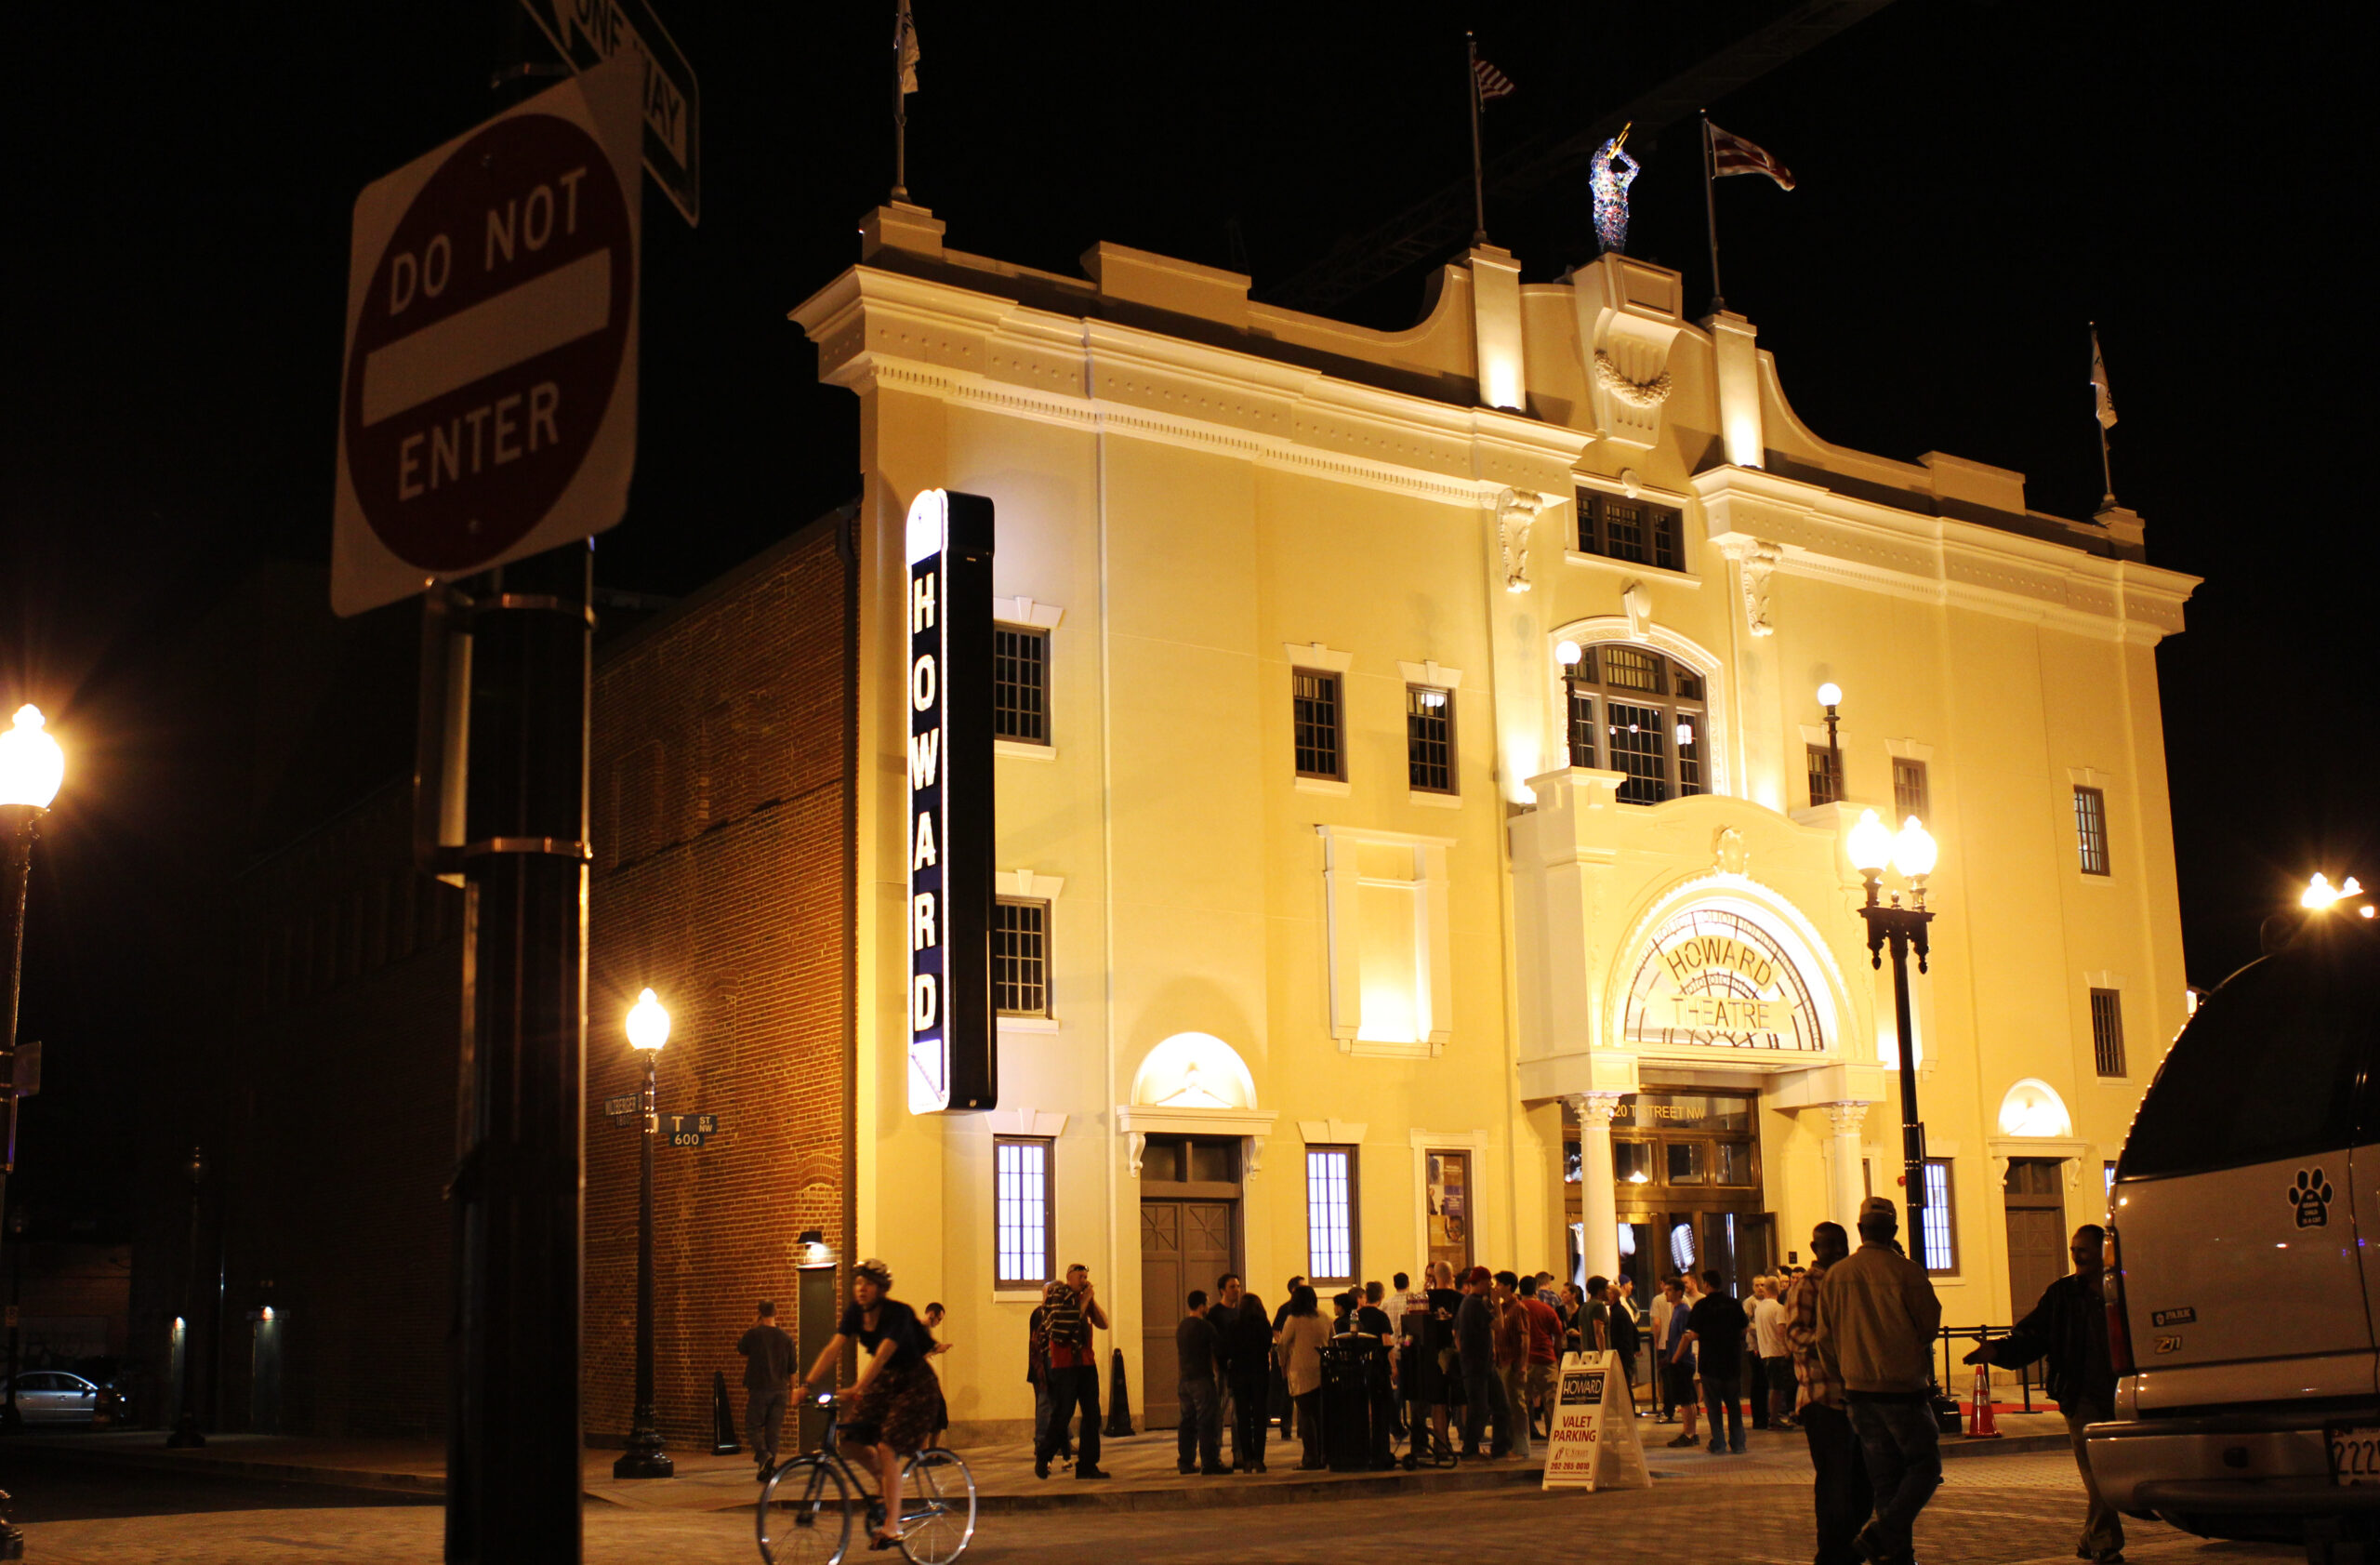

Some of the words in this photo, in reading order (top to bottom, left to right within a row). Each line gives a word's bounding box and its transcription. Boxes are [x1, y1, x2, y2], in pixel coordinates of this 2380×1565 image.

[640, 50, 680, 141] AY
[389, 233, 452, 317] DO
[484, 166, 588, 272] NOT
[397, 380, 560, 501] ENTER
[912, 573, 939, 1031] HOWARD
[1667, 938, 1771, 987] HOWARD
[1672, 997, 1771, 1029] THEATRE
[1629, 1104, 1637, 1118] T
[1639, 1105, 1685, 1120] STREET
[1686, 1107, 1706, 1120] NW
[670, 1116, 684, 1133] T
[699, 1116, 711, 1125] ST
[698, 1124, 713, 1134] NW
[674, 1134, 699, 1146] 600
[1563, 1379, 1602, 1395] HOWARD
[1563, 1416, 1593, 1428] VALET
[1553, 1429, 1597, 1442] PARKING
[2334, 1440, 2380, 1475] 222
